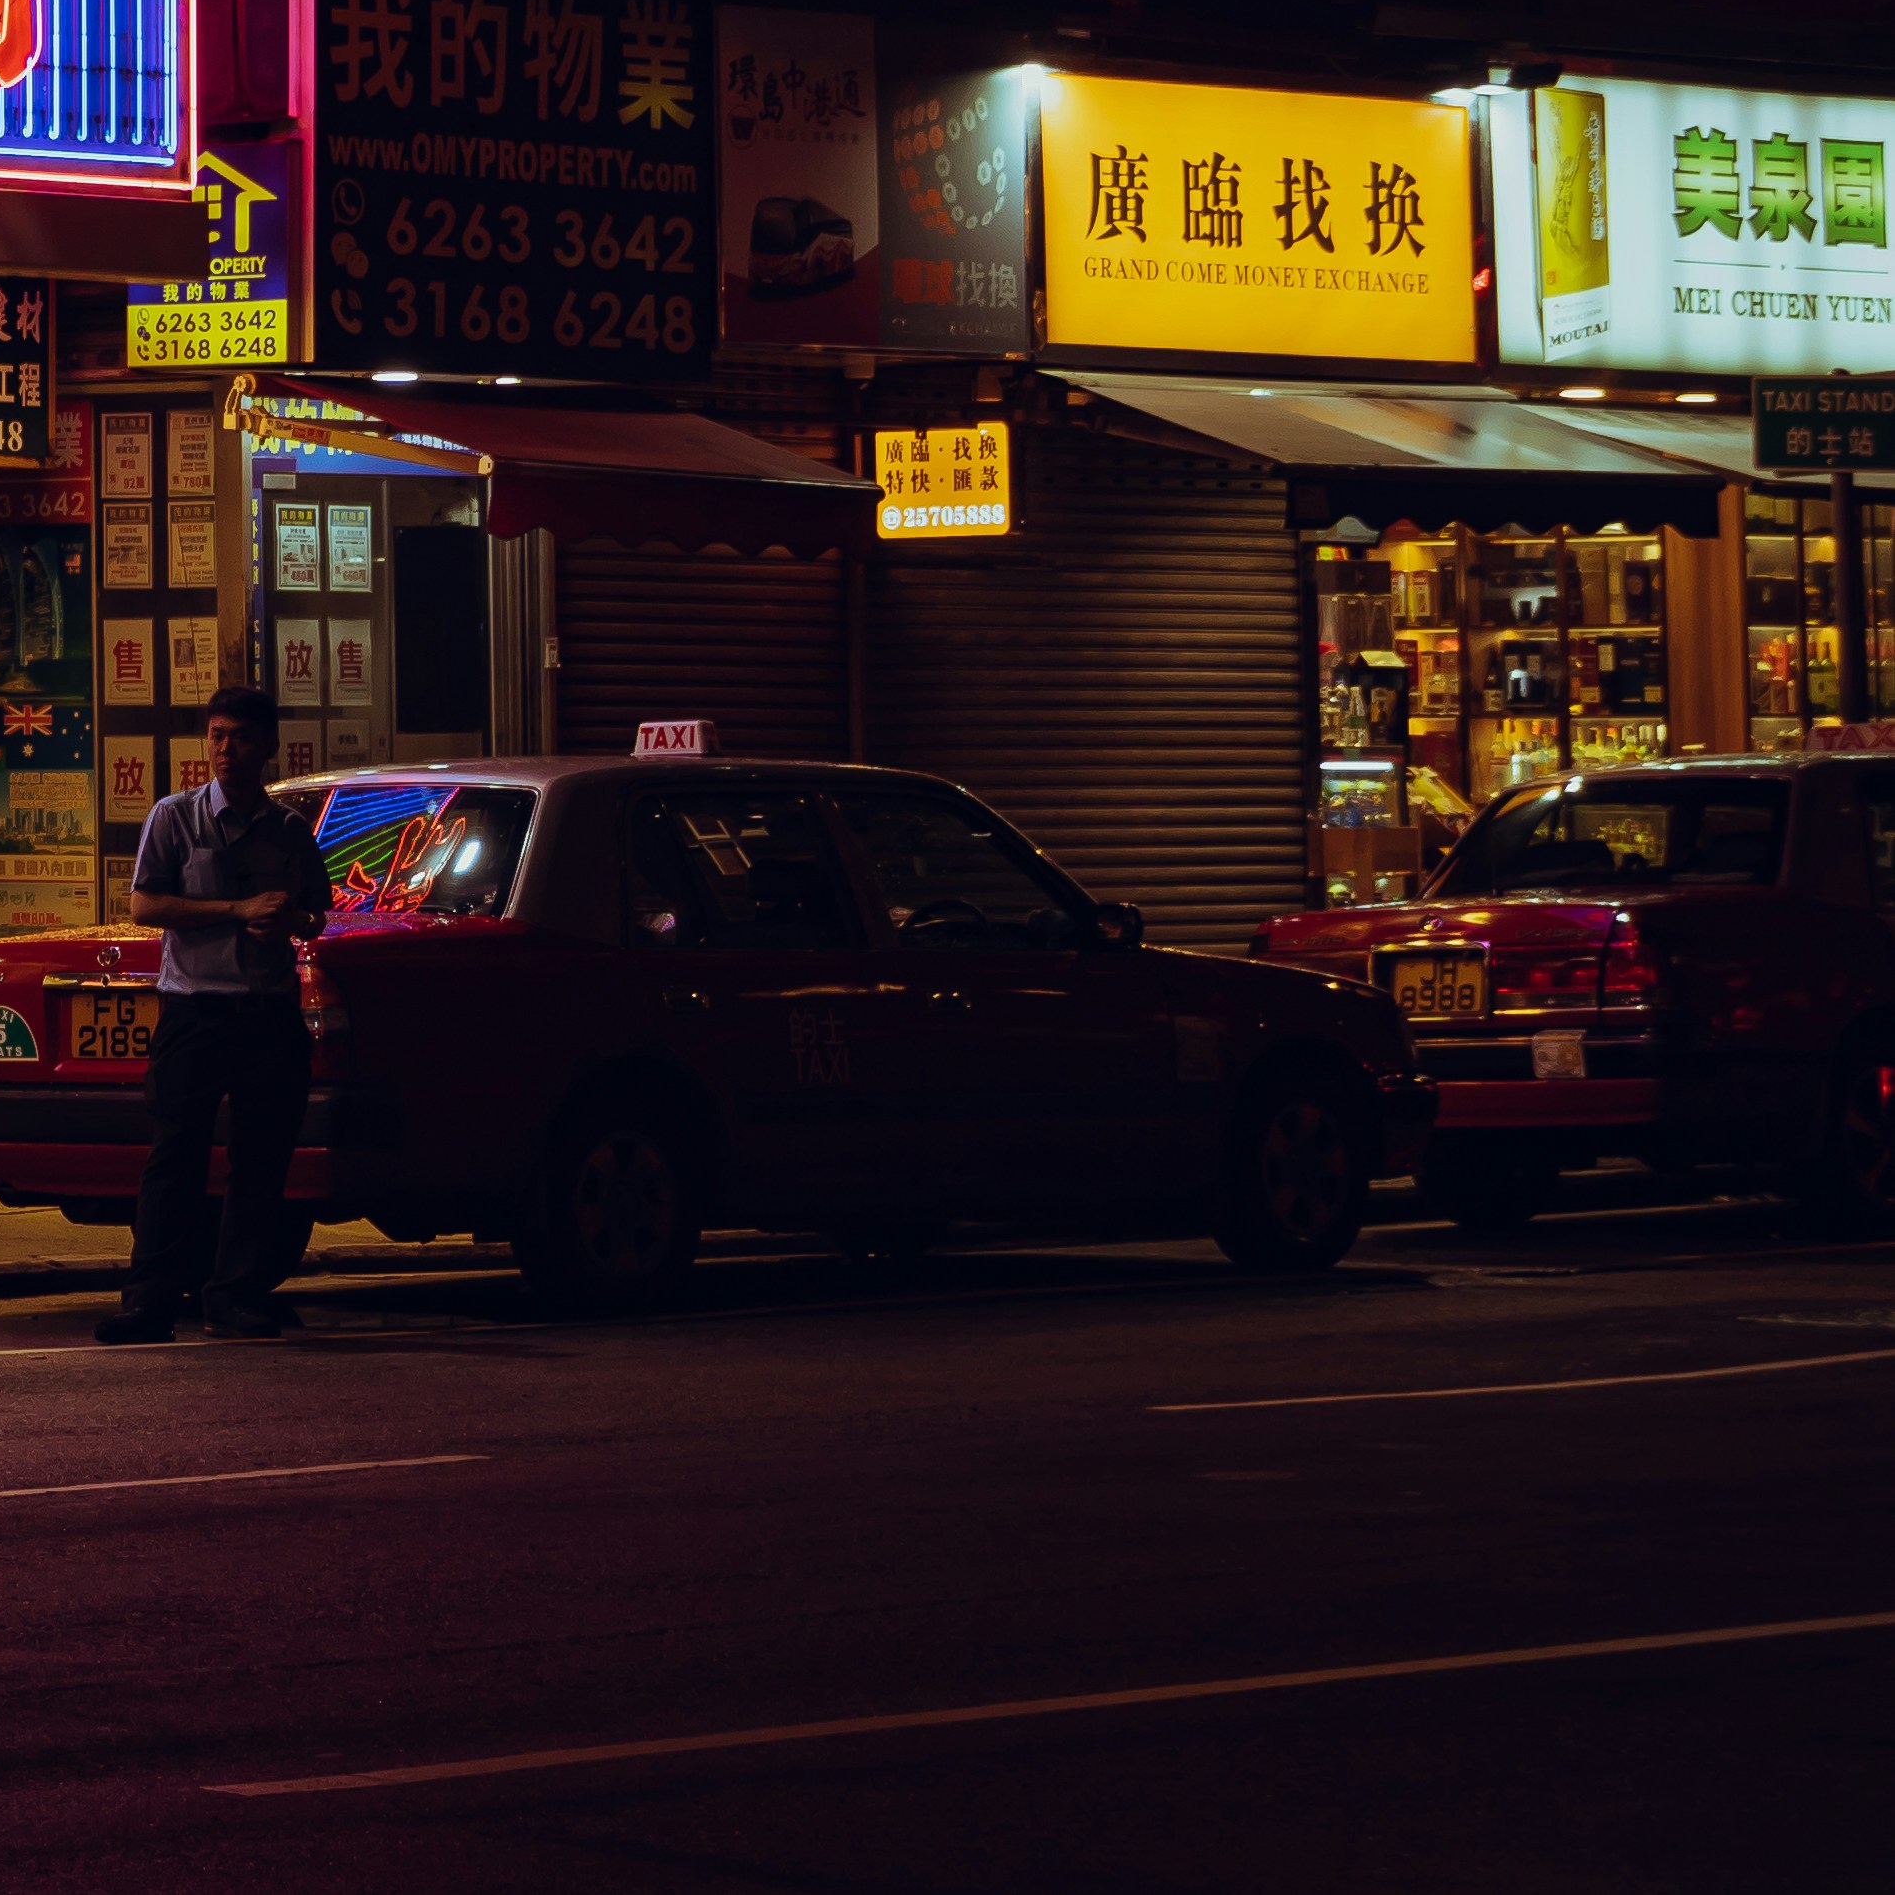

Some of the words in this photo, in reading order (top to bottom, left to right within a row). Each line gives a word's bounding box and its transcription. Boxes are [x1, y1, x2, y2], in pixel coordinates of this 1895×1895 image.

[1084, 145, 1426, 258] 廣臨找換
[1672, 126, 1887, 250] 美泉園
[387, 196, 531, 263] 6263
[553, 209, 695, 274] 3642
[164, 282, 250, 302] 我的物業
[1084, 256, 1159, 281] GRAND
[1166, 261, 1228, 285] COME
[1234, 265, 1308, 289] MONEY
[1314, 268, 1430, 295] EXCHANGE
[156, 312, 211, 333] 6263
[220, 309, 277, 331] 3642
[384, 277, 531, 344] 3168
[554, 290, 696, 355] 6248
[1674, 287, 1721, 314] MEI
[1732, 290, 1818, 320] CHUEN
[1828, 295, 1892, 324] YUEN
[155, 340, 211, 360] 3168
[220, 336, 277, 358] 6248
[1549, 320, 1609, 347] MOUTAI
[1763, 390, 1810, 412] TAXI
[1817, 390, 1895, 413] STAND
[1786, 425, 1876, 456] 的士站
[22, 490, 86, 517] 3642
[113, 639, 143, 679] 售
[285, 639, 313, 679] 放
[337, 639, 364, 679] 售
[641, 726, 695, 750] TAXI
[113, 756, 145, 796] 放
[1421, 957, 1456, 985] JH
[94, 994, 135, 1025] FG
[789, 1007, 843, 1046] 的士
[79, 1025, 151, 1057] 2189
[790, 1048, 852, 1084] TAXI
